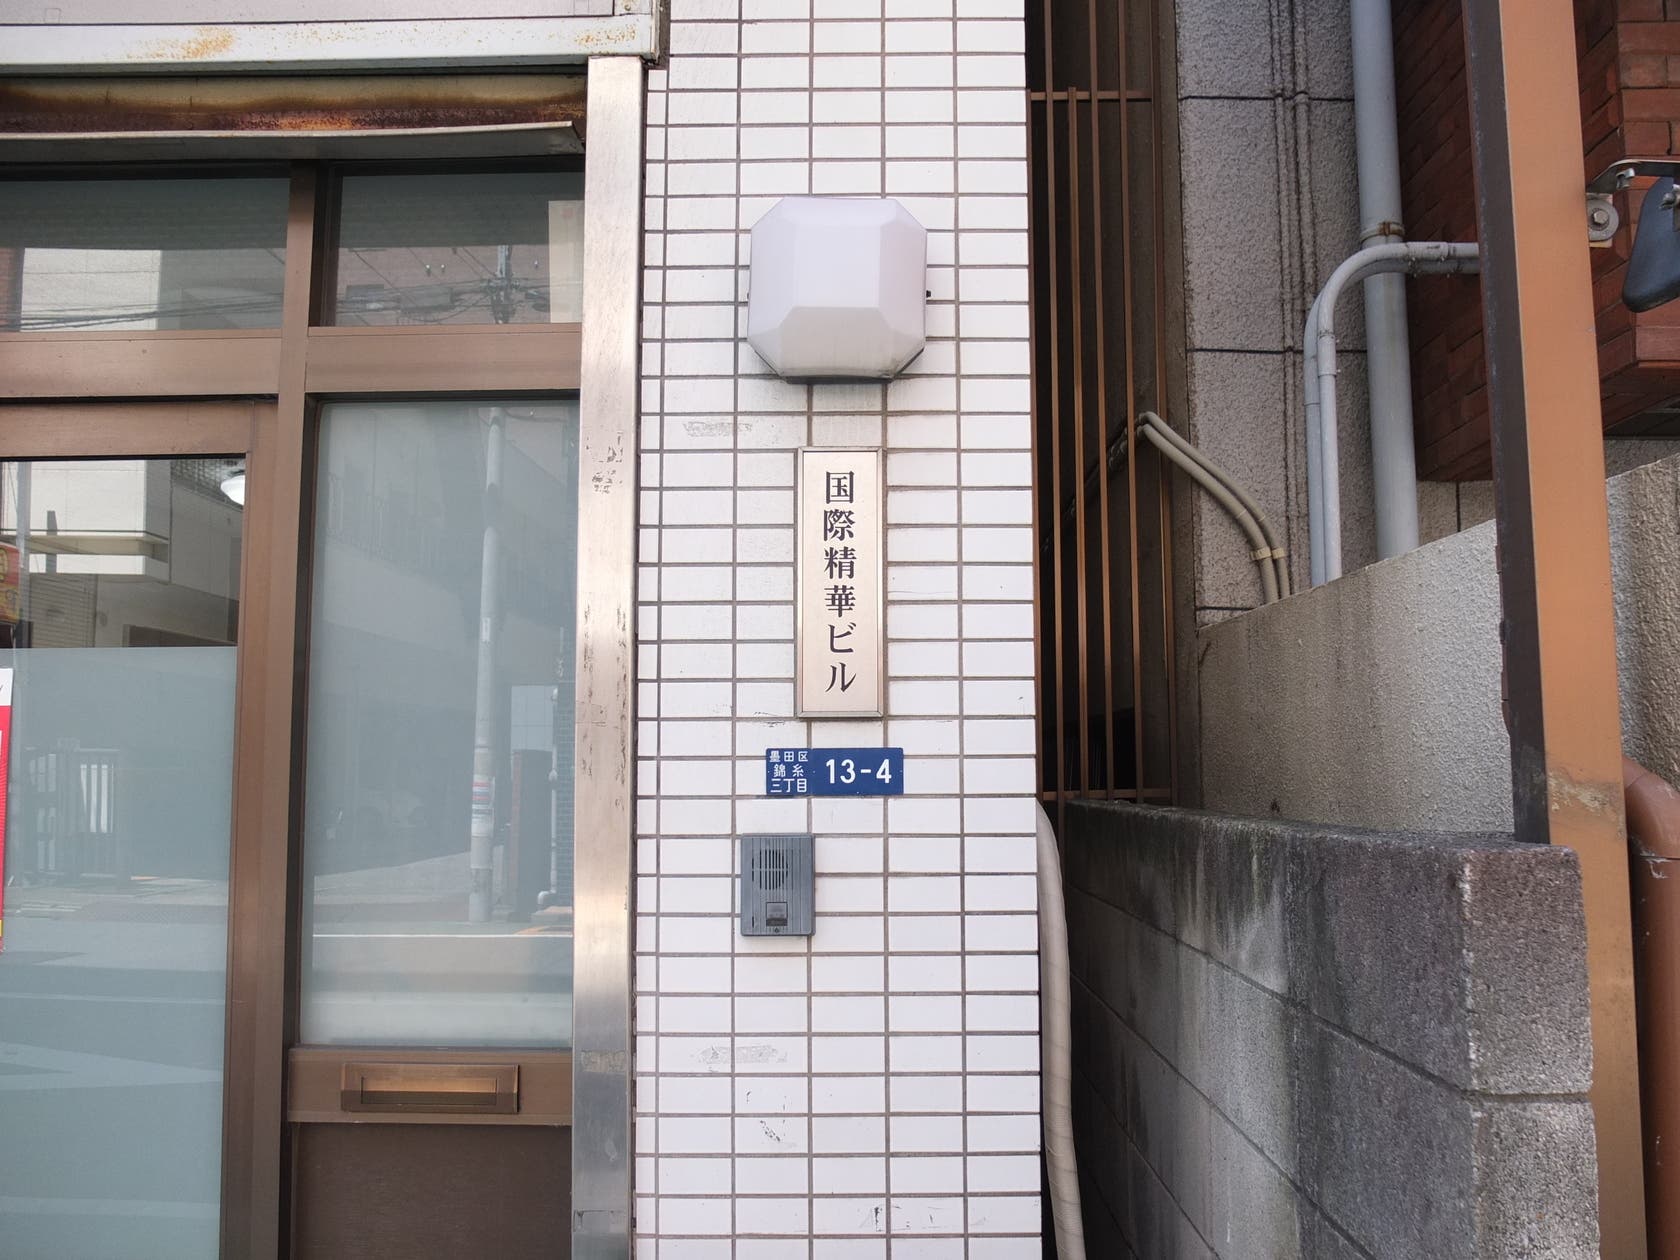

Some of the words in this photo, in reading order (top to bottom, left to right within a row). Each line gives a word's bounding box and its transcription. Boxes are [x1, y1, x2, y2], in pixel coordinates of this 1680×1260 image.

[823, 471, 857, 692] 国際精華ビル
[770, 750, 808, 762] 墨田区
[773, 763, 804, 777] 錦糸
[825, 758, 892, 784] 13-4
[770, 778, 807, 793] 三丁目
